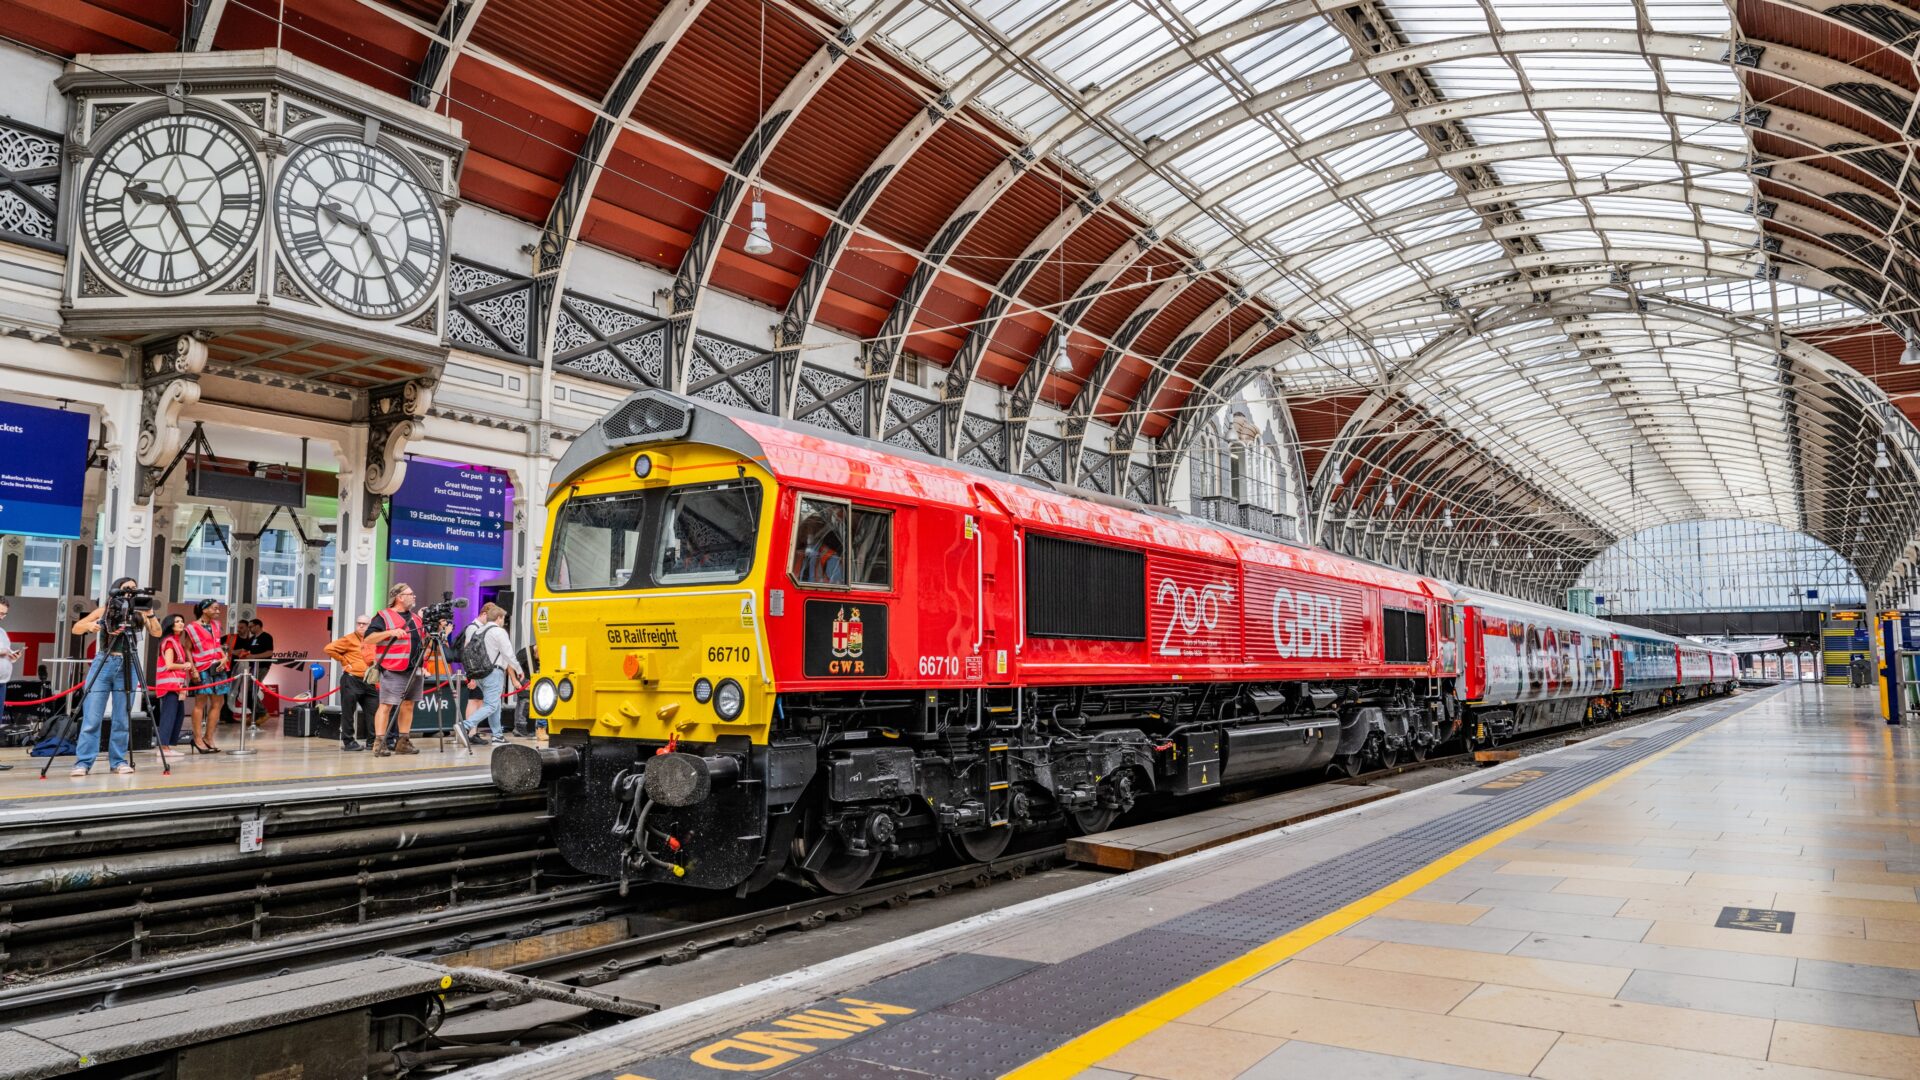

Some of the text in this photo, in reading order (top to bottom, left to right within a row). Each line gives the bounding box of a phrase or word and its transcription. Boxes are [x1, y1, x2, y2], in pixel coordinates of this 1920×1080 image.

[460, 471, 483, 480] Car park
[434, 486, 482, 500] First Class Lounge
[444, 480, 483, 492] Great Western
[410, 510, 481, 526] 19 Eastbourne Terrace
[446, 526, 485, 538] Platform 14
[412, 539, 459, 552] Elizabeth line
[1272, 587, 1342, 659] GBRf
[607, 627, 679, 647] GB Railfreight
[708, 646, 750, 663] 66710
[829, 659, 865, 674] GWR
[918, 655, 959, 676] 66710
[418, 693, 449, 713] GWR
[690, 997, 917, 1072] MIND
